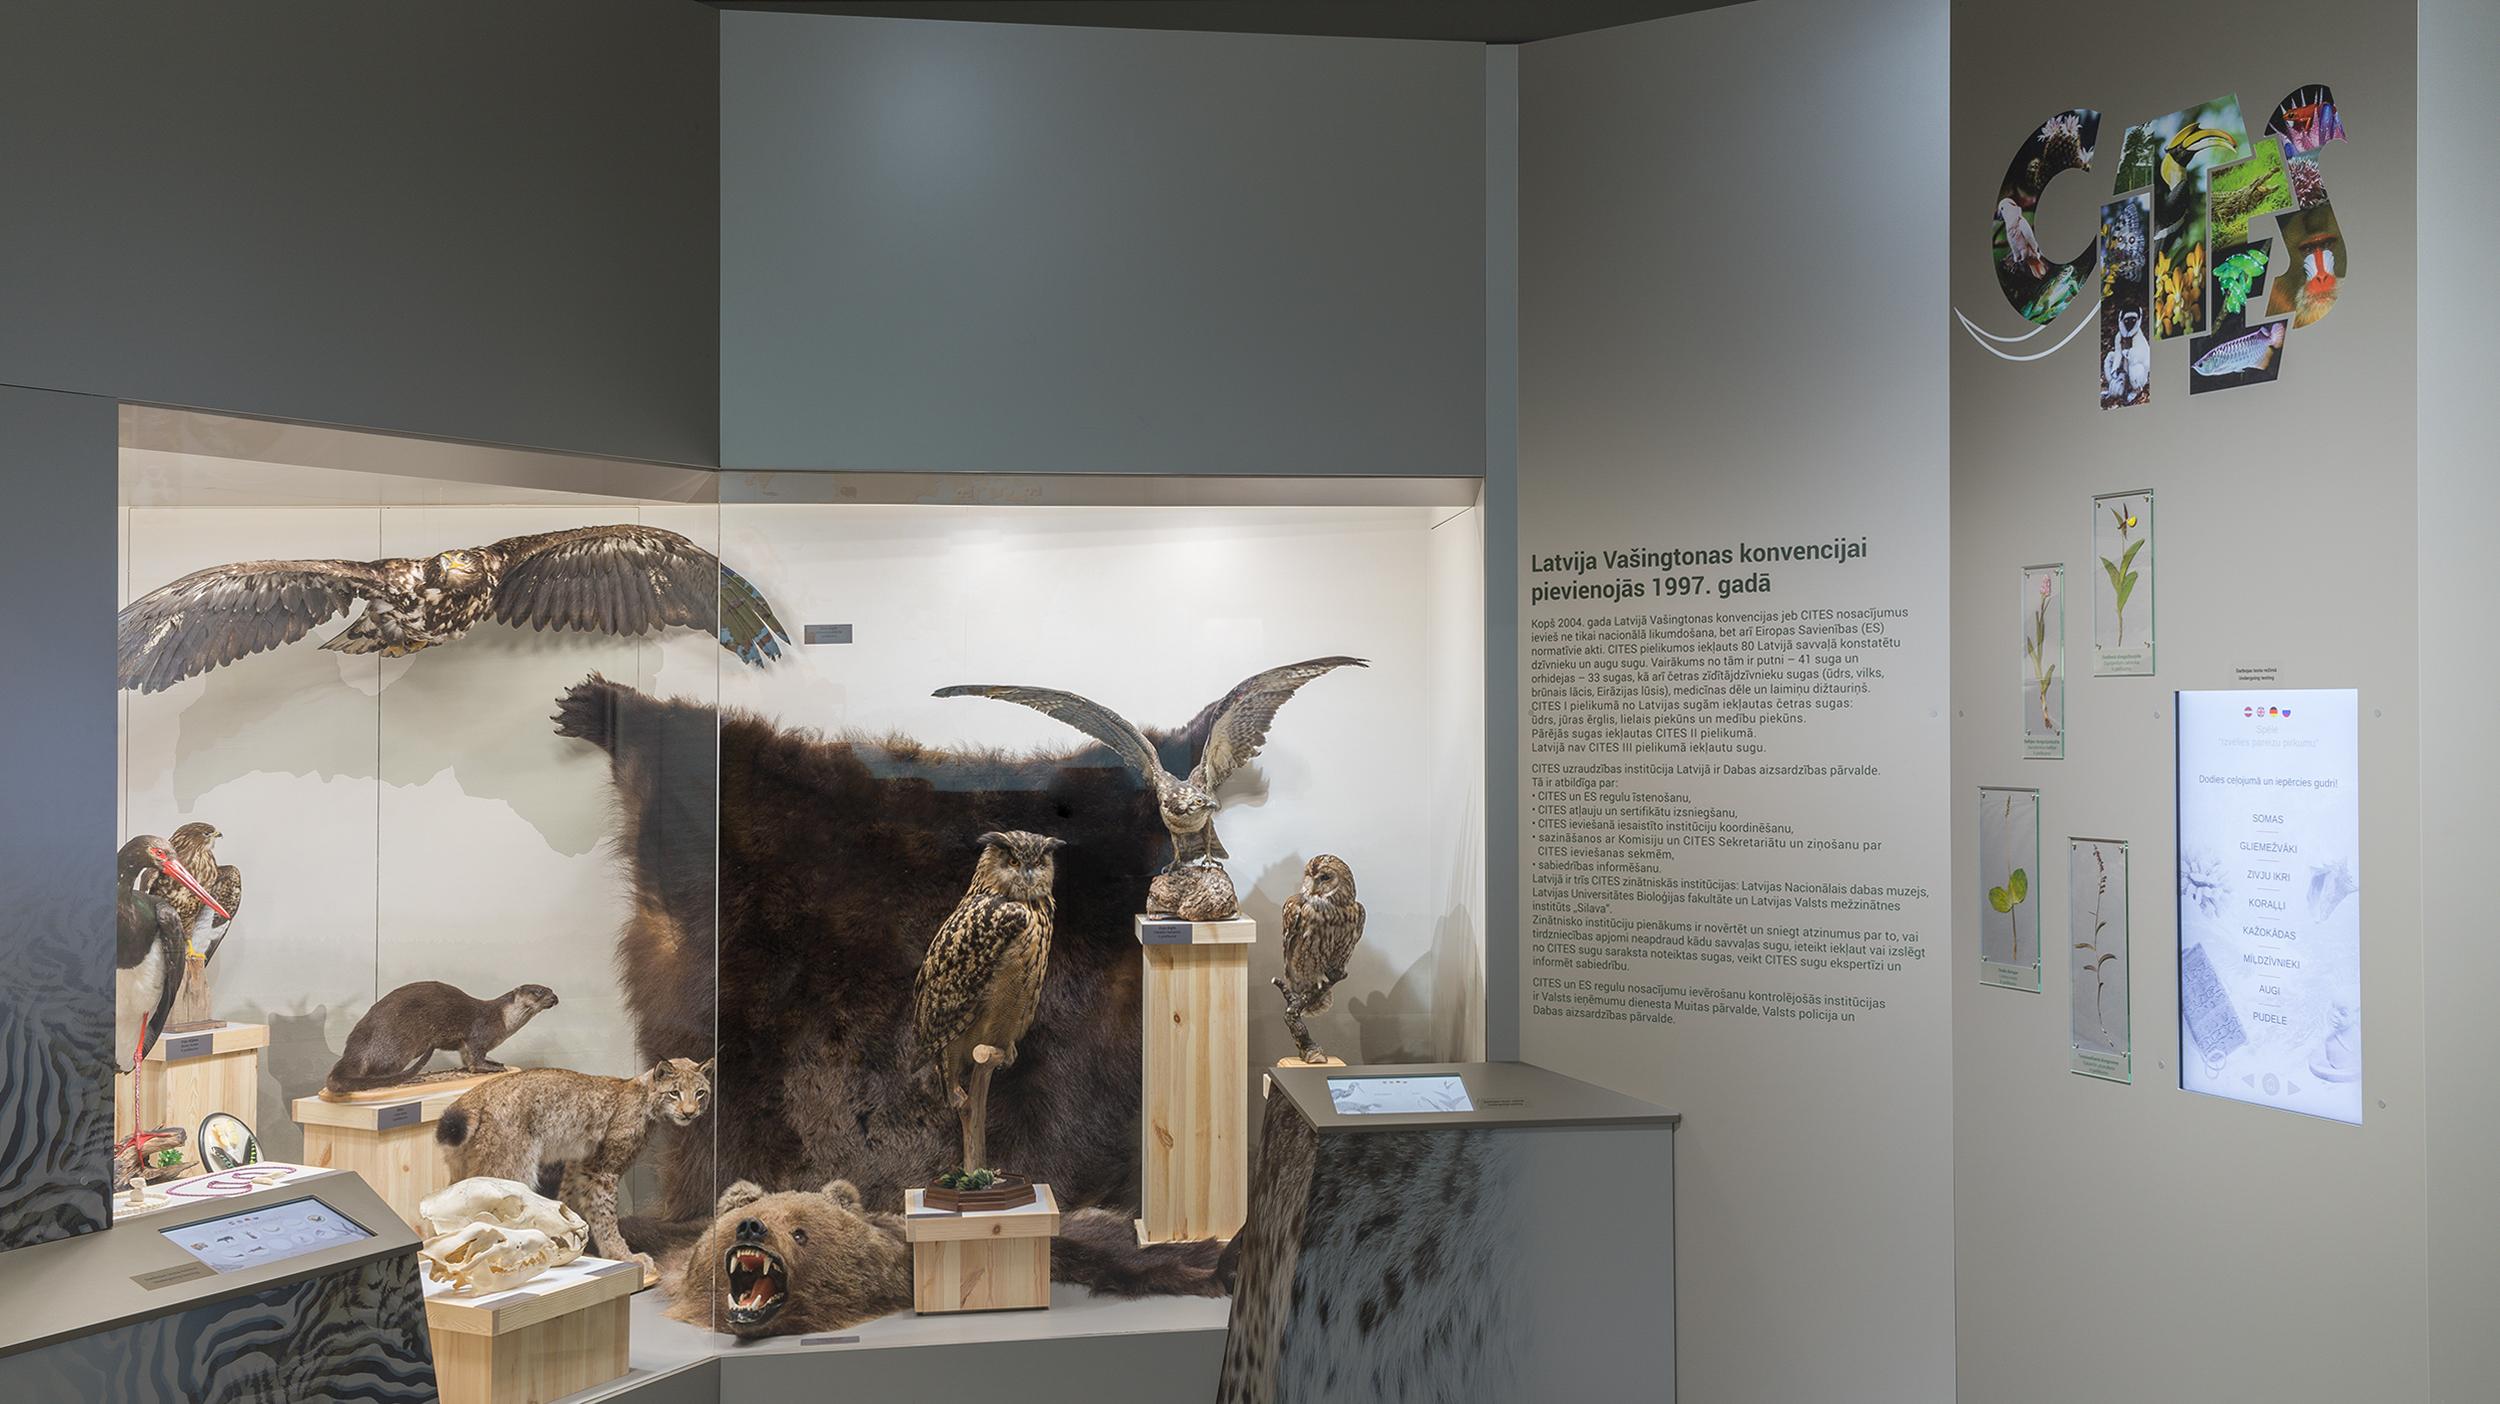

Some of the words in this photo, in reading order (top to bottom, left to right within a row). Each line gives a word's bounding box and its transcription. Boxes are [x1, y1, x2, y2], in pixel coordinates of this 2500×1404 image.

[1992, 84, 2350, 410] CITES
[1532, 551, 1596, 574] Latvija
[1603, 548, 1732, 571] Vašingtonas
[1740, 537, 1866, 563] konvencijai
[1532, 578, 1644, 605] pievienojās
[1652, 575, 1710, 596] 1997.
[1718, 572, 1770, 598] gadā
[1531, 618, 1555, 631] Kopš
[1557, 617, 1585, 628] 2004.
[1586, 616, 1611, 630] gada
[1614, 615, 1647, 628] Latvijā
[1649, 614, 1713, 627] Vašingtonas
[1715, 610, 1778, 624] konvencijas
[1800, 608, 1833, 621] CITES
[1835, 607, 1908, 622] nosacījumus
[1531, 631, 1558, 643] ievieš
[1575, 630, 1595, 641] tikai
[1598, 629, 1646, 642] nacionālā
[1649, 627, 1719, 639] likumdošana,
[1755, 625, 1795, 638] Eiropas
[1798, 623, 1857, 635] Savienības
[1531, 644, 1582, 659] normatīvie
[1584, 643, 1607, 655] akti.
[1607, 643, 1637, 655] CITES
[1639, 642, 1695, 655] pielikumos
[1697, 641, 1738, 654] iekļauts
[1757, 639, 1792, 652] Latvijā
[1795, 638, 1837, 651] savvaļā
[1839, 637, 1900, 649] konstatētu
[1531, 658, 1576, 670] dzīvnieku
[1593, 660, 1618, 671] augu
[1621, 659, 1649, 670] sugu.
[1650, 656, 1704, 667] Vairākums
[1756, 654, 1783, 667] putni
[1815, 655, 1841, 666] suga
[1531, 672, 1575, 686] orhidejas
[1602, 673, 1635, 685] sugas,
[1667, 670, 1699, 681] četras
[1702, 668, 1783, 683] zīdītājdzīvnieku
[1786, 670, 1819, 682] sugas
[1822, 667, 1856, 681] (ūdrs,
[1856, 666, 1884, 679] vilks,
[1531, 686, 1567, 699] brūnais
[1569, 686, 1597, 697] lācis,
[1641, 684, 1673, 698] lūsis),
[1673, 684, 1726, 698] medicīnas
[1728, 683, 1751, 695] dēle
[1770, 682, 1809, 696] laimiņu
[1531, 700, 1561, 714] CITES
[1569, 699, 1619, 712] pielikumā
[1638, 698, 1679, 712] Latvijas
[1722, 698, 1773, 711] iekļautas
[1775, 697, 1811, 709] četras
[1815, 699, 1852, 711] sugas:
[1531, 714, 1559, 725] ūdrs,
[1559, 714, 1583, 727] jūras
[1587, 713, 1618, 727] ērglis,
[1620, 713, 1650, 724] lielais
[1654, 713, 1695, 726] piekūns
[1715, 712, 1755, 724] medību
[1759, 712, 1806, 725] piekūns.
[1531, 728, 1569, 740] Pārējās
[1571, 730, 1602, 741] sugas
[1605, 727, 1652, 740] iekļautas
[1655, 727, 1687, 738] CITES
[1700, 727, 1756, 740] pielikumā.
[1531, 741, 1564, 755] Latvijā
[1588, 741, 1619, 752] CITES
[1635, 741, 1686, 754] pielikumā
[1689, 741, 1732, 754] iekļautu
[1736, 744, 1766, 755] sugu.
[1531, 763, 1560, 774] CITES
[1562, 763, 1621, 775] uzraudzības
[1624, 763, 1673, 776] institūcija
[1676, 763, 1710, 777] Latvijā
[1723, 763, 1756, 775] Dabas
[1759, 764, 1826, 775] aizsardzības
[1830, 764, 1880, 777] pārvalde.
[2199, 774, 2225, 784] Dodies
[2263, 777, 2274, 786] un
[1537, 790, 1566, 801] CITES
[1632, 791, 1691, 804] īstenošanu,
[1537, 804, 1566, 815] CITES
[1568, 804, 1602, 818] atļauju
[1619, 805, 1670, 817] sertifikātu
[1673, 806, 1737, 820] izsniegšanu,
[2252, 813, 2285, 824] SOMAS
[1538, 818, 1566, 829] CITES
[1569, 818, 1614, 830] ieviešanā
[1617, 819, 1663, 831] iesaistīto
[1666, 820, 1716, 834] institūciju
[1719, 821, 1794, 835] koordinēšanu,
[1539, 831, 1601, 844] sazināšanos
[1618, 833, 1663, 847] Komisiju
[1683, 835, 1715, 846] CITES
[1718, 835, 1785, 848] Sekretariātu
[1807, 838, 1858, 851] ziņošanu
[2239, 840, 2298, 854] GLIEMEŽVĀKI
[1537, 845, 1567, 857] CITES
[1570, 846, 1624, 858] ieviešanas
[1627, 848, 1674, 860] sekmēm,
[1537, 859, 1594, 871] sabiedrības
[1596, 860, 1662, 874] informēšanu.
[2247, 869, 2271, 881] ZIVJU
[2272, 871, 2291, 882] IKRI
[1532, 873, 1562, 886] Latvijā
[1591, 875, 1620, 886] CITES
[1622, 876, 1678, 888] zinātniskās
[1741, 880, 1781, 894] Latvijas
[1784, 882, 1847, 894] Nacionālais
[1849, 884, 1883, 896] dabas
[1532, 887, 1568, 900] Latvijas
[1636, 890, 1685, 905] Bioloģijas
[1687, 892, 1732, 904] fakultāte
[1750, 895, 1791, 909] Latvijas
[1794, 896, 1827, 908] Valsts
[1830, 898, 1900, 911] mežzinātnes
[2248, 897, 2286, 911] KORAĻĻI
[2242, 925, 2297, 941] KAŽOKĀDAS
[1532, 976, 1561, 988] CITES
[1627, 984, 1686, 997] nosacījumu
[1689, 986, 1745, 1000] ievērošanu
[1748, 990, 1821, 1007] kontrolējošās
[1824, 994, 1885, 1010] institūcijas
[2258, 984, 2281, 996] AUGI
[1533, 1004, 1563, 1016] Dabas
[1565, 1006, 1627, 1020] aizsardzības
[1629, 1011, 1675, 1024] pārvalde.
[1541, 991, 1571, 1003] Valsts
[1574, 993, 1625, 1008] ieņēmumu
[1628, 996, 1671, 1010] dienesta
[1674, 999, 1709, 1012] Muitas
[1712, 1002, 1760, 1016] pārvalde,
[1762, 1005, 1795, 1018] Valsts
[1798, 1008, 1837, 1022] policija
